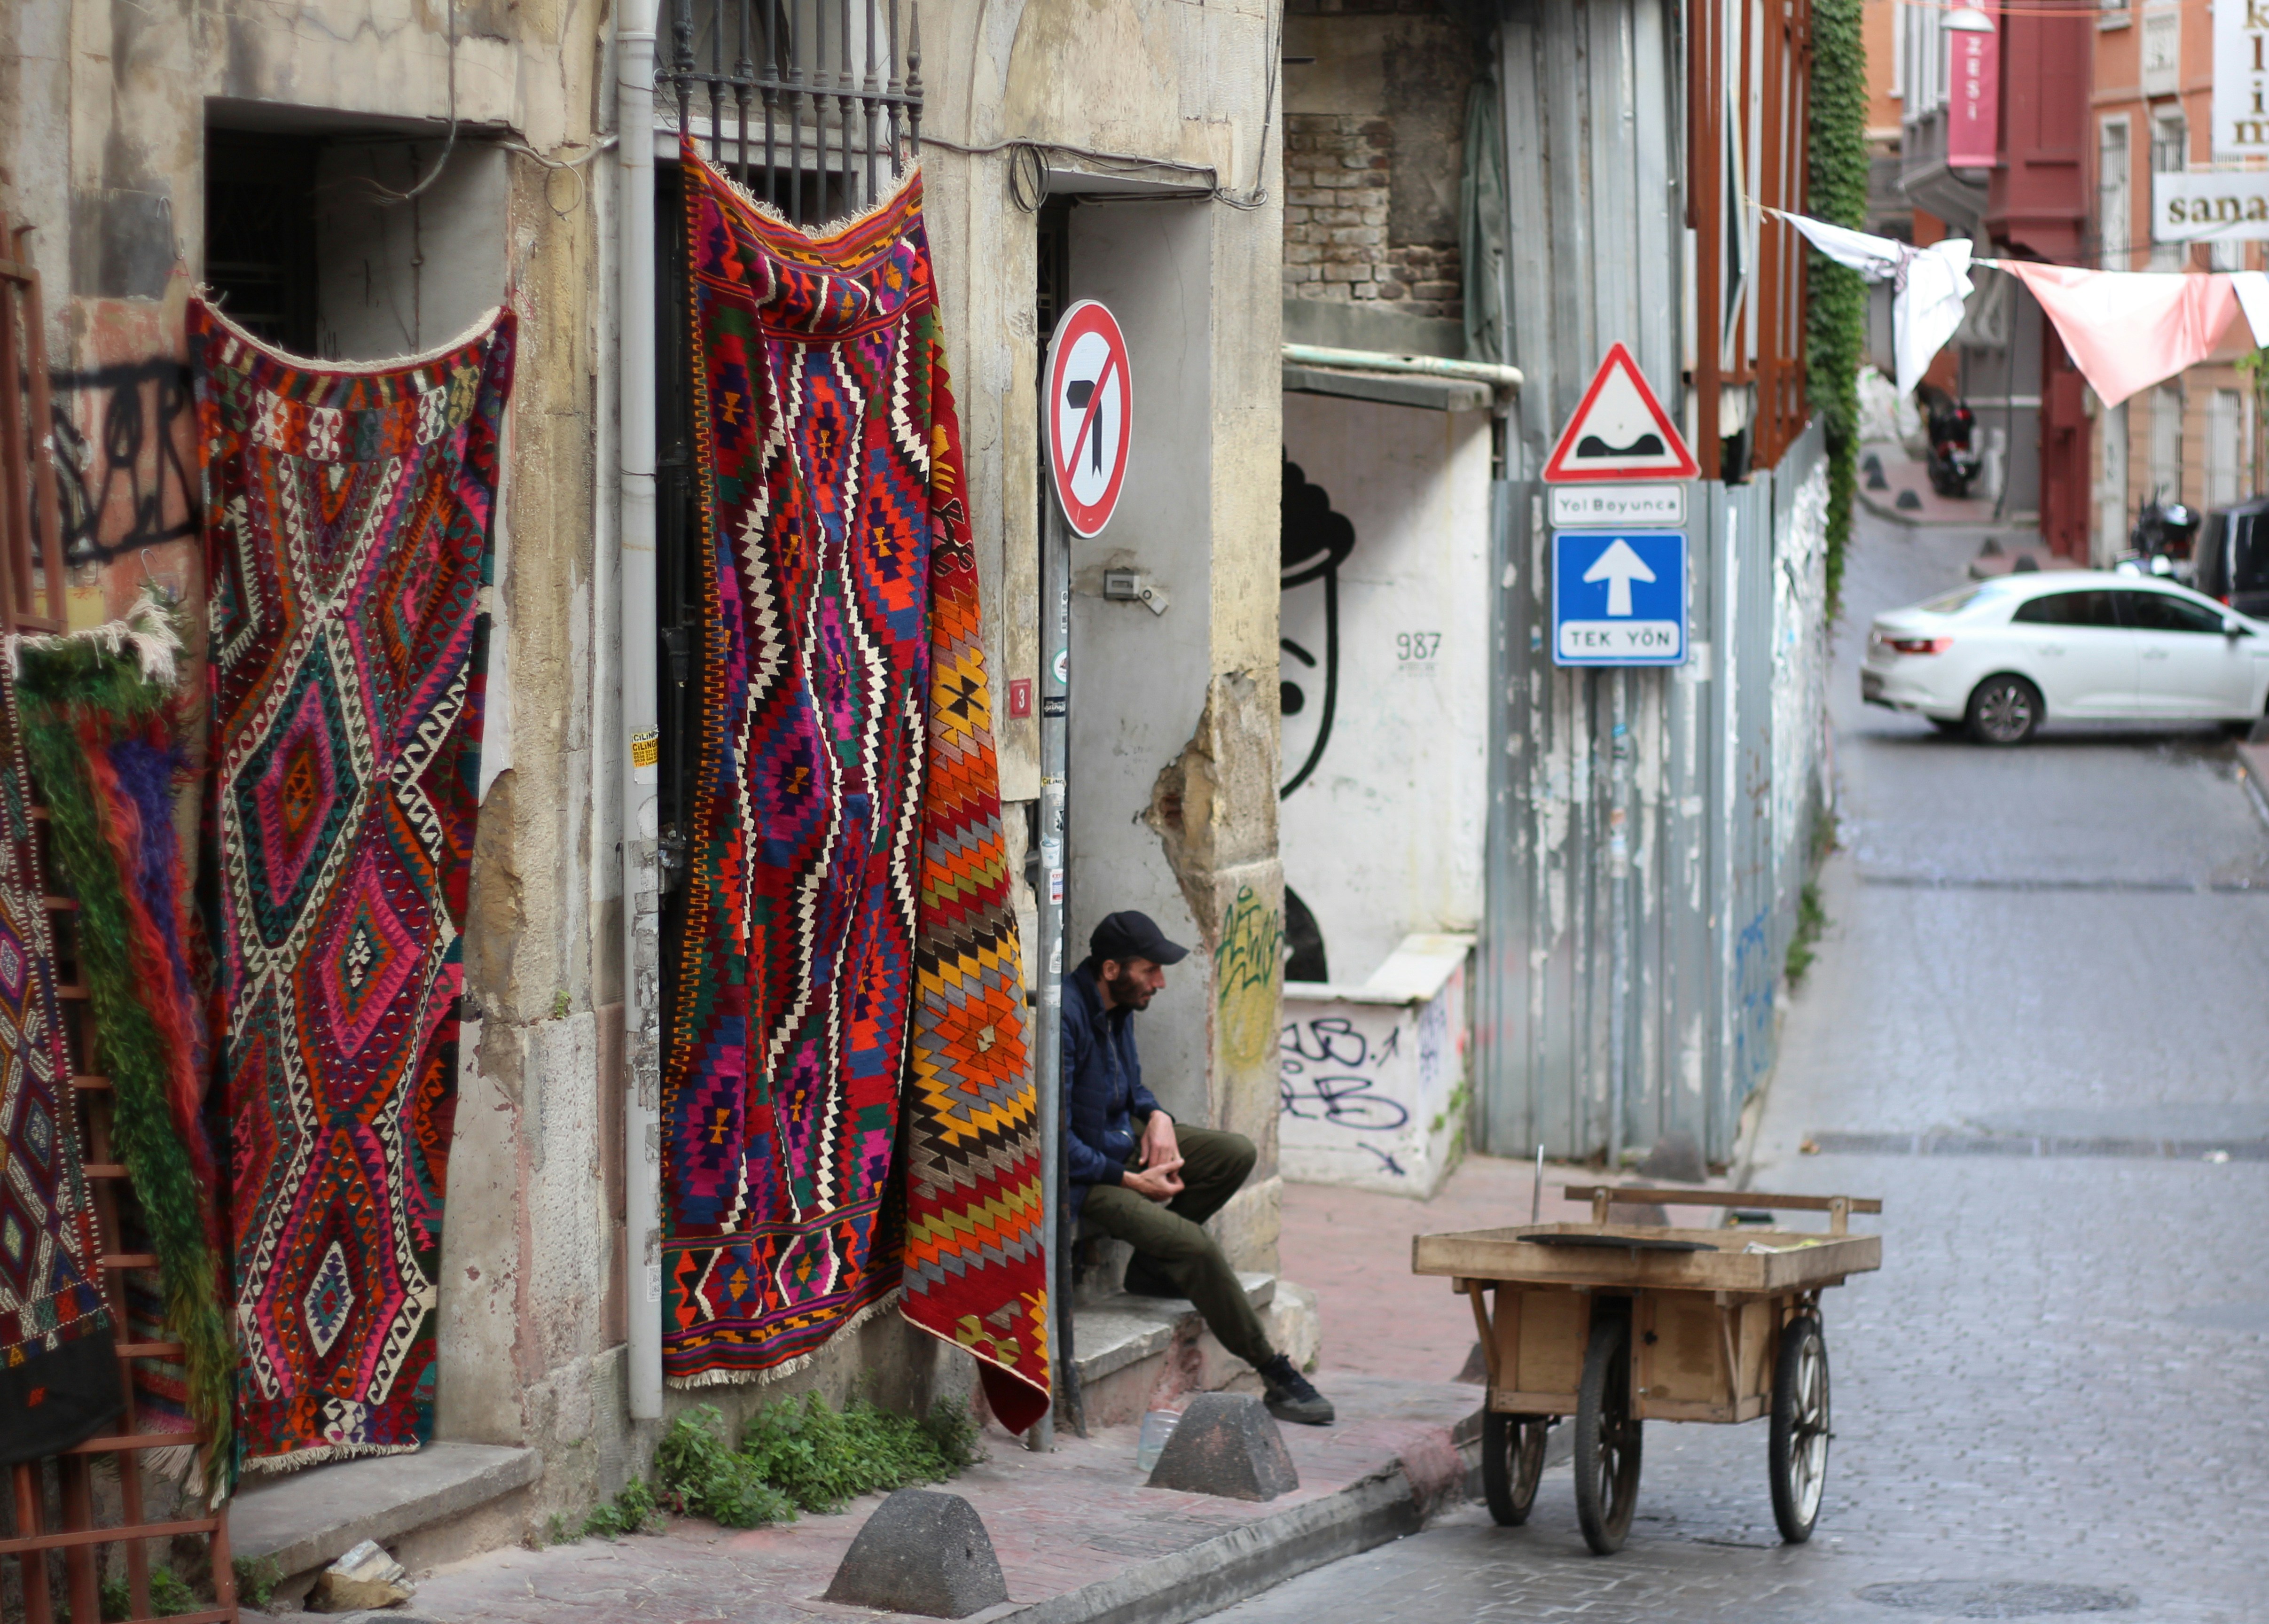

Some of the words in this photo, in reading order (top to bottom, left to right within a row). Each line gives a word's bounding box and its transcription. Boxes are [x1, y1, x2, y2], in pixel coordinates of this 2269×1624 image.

[1559, 499, 1587, 512] Yol
[1593, 498, 1676, 515] Boyunca
[1397, 632, 1442, 661] 987
[1570, 631, 1611, 647] TEK
[1627, 627, 1670, 647] YÖN
[1018, 688, 1025, 709] 3
